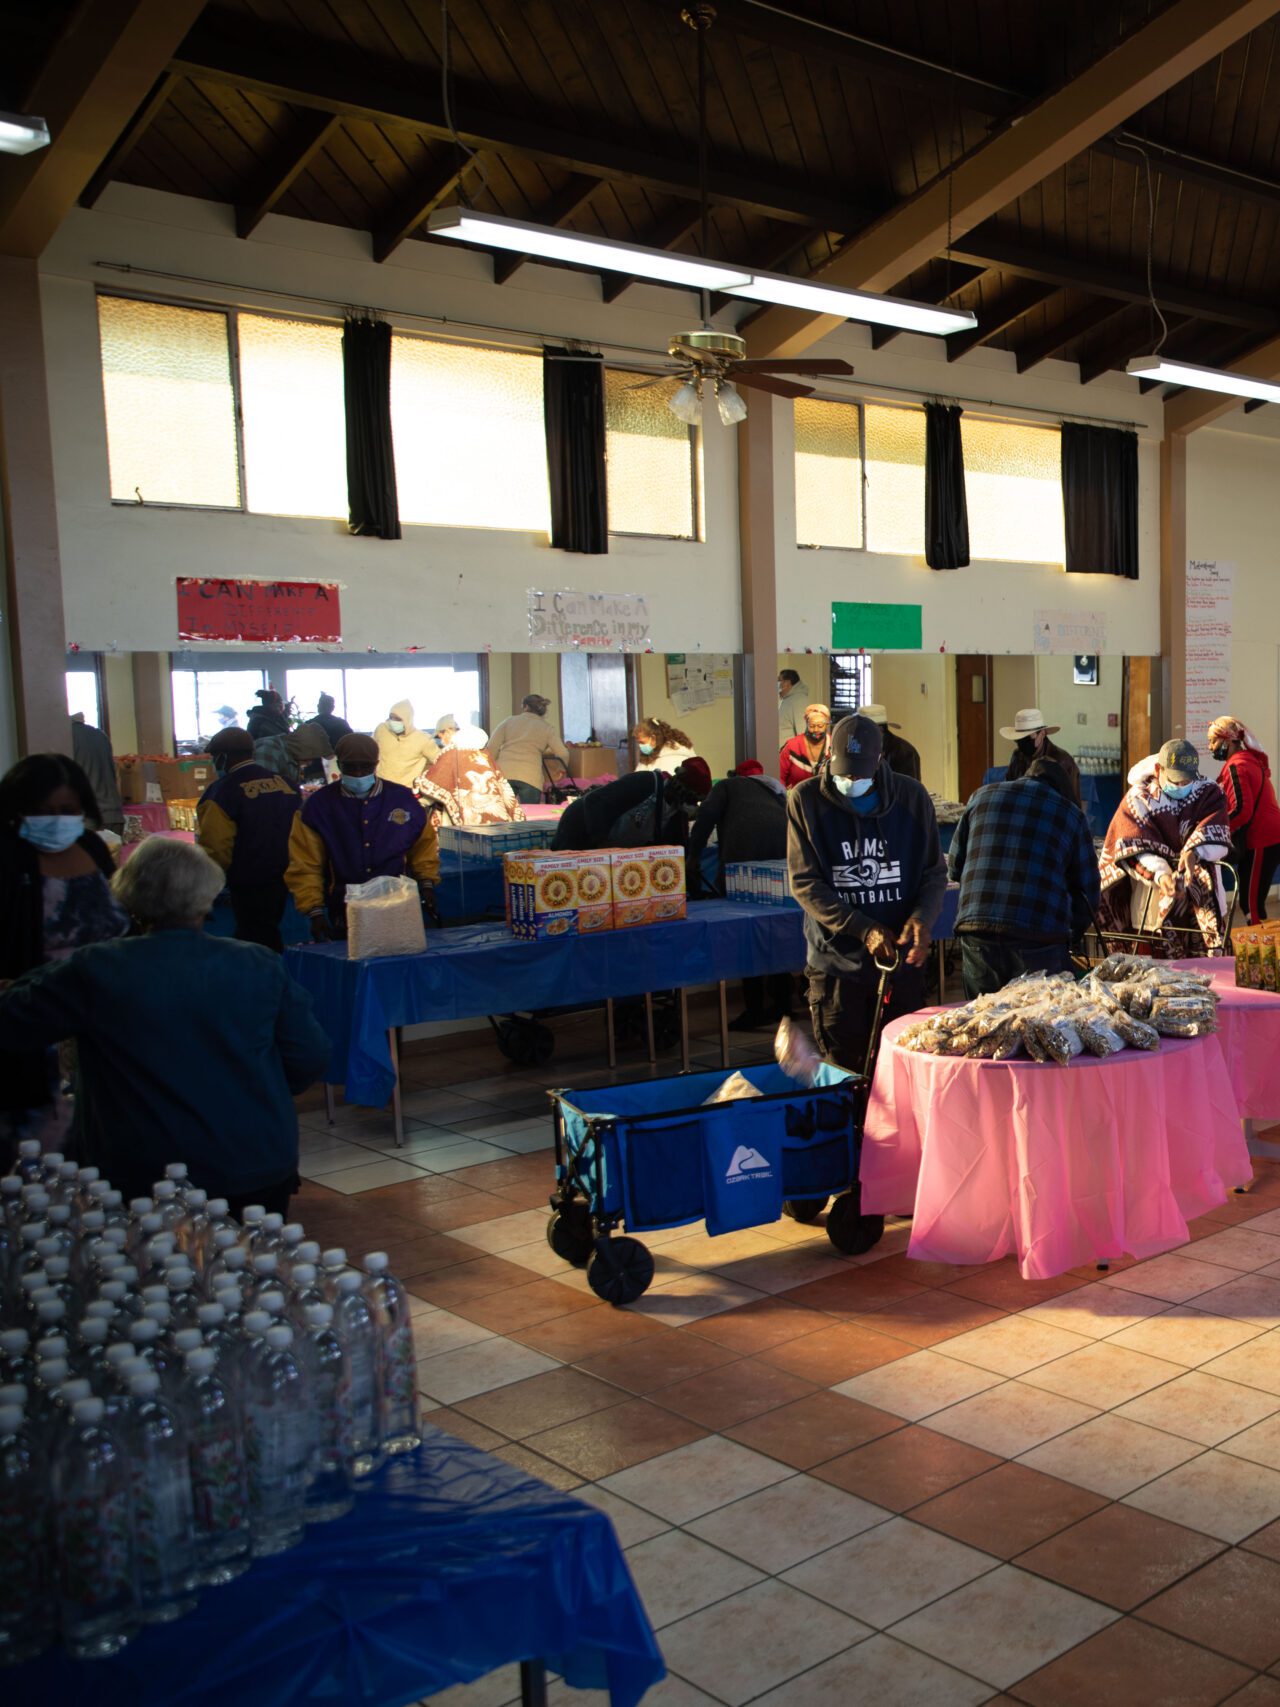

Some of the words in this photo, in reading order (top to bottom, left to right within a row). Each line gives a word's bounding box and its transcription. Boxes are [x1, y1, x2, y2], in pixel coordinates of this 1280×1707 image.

[199, 580, 254, 601] CAN
[315, 586, 330, 602] A
[534, 592, 546, 612] I
[840, 837, 888, 860] RAMS
[838, 888, 902, 905] OOTBALL
